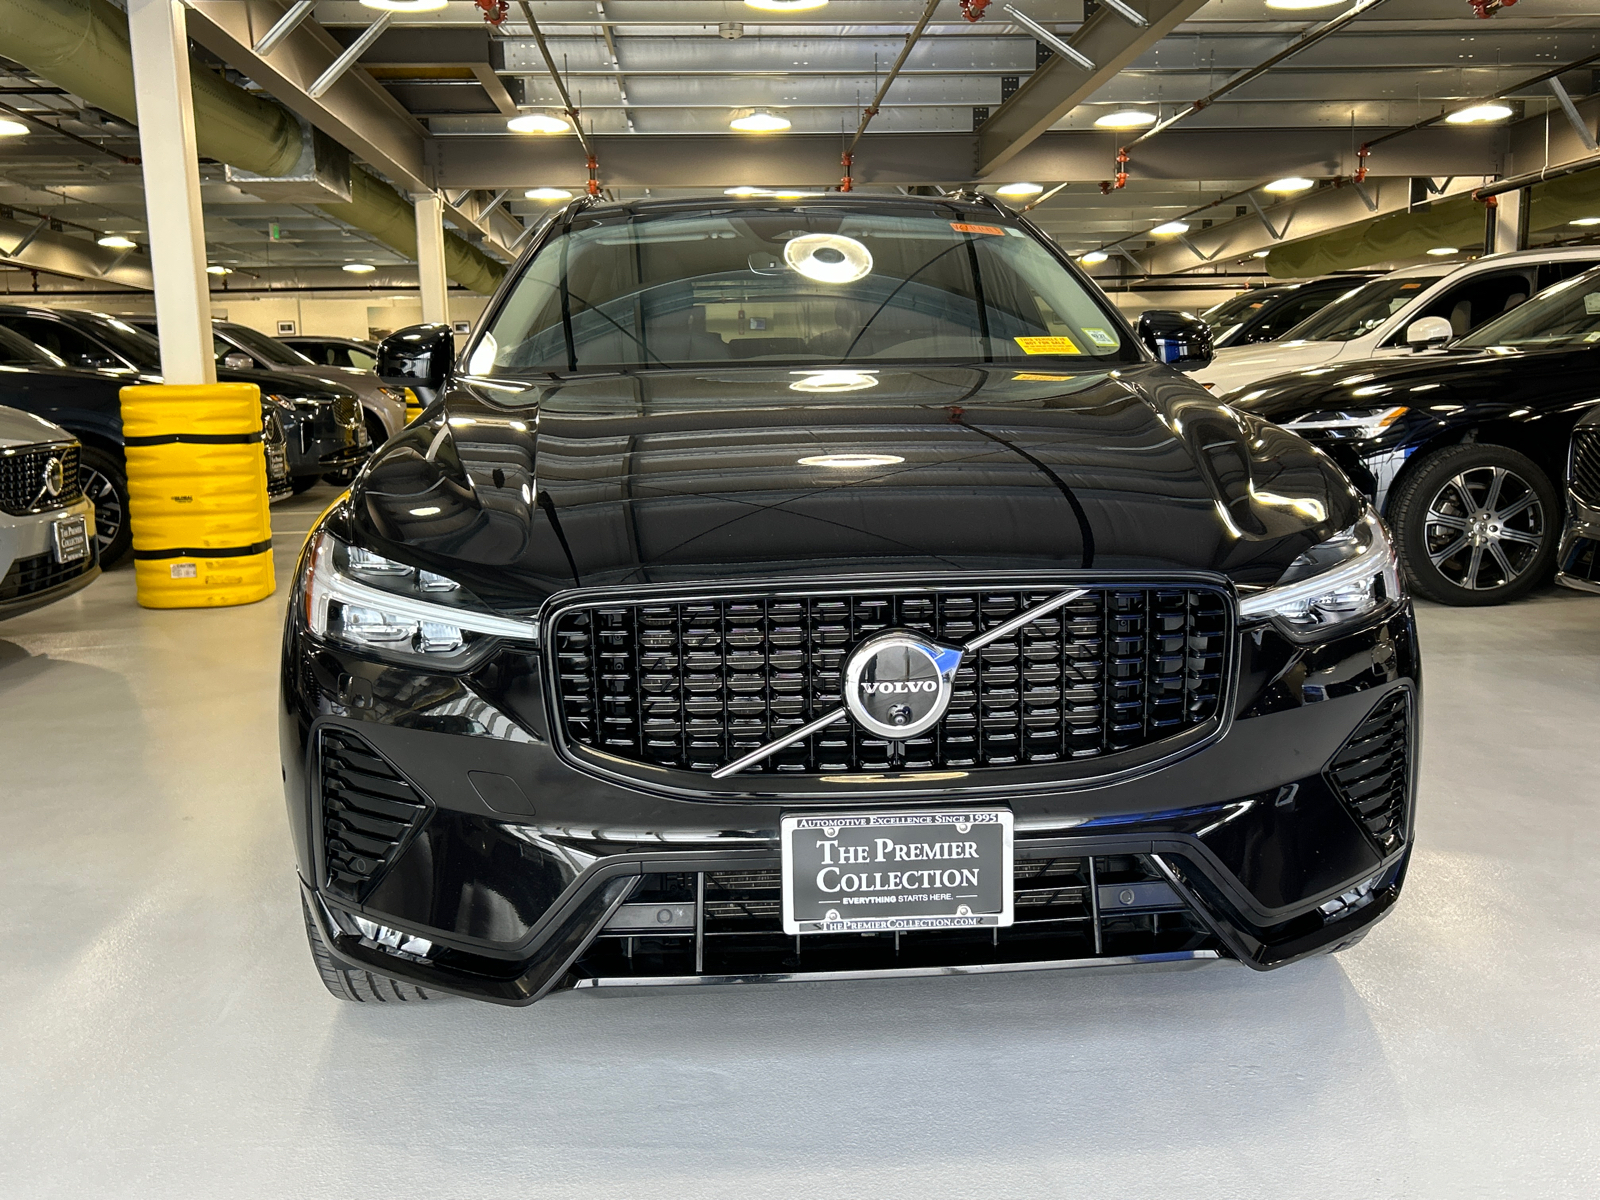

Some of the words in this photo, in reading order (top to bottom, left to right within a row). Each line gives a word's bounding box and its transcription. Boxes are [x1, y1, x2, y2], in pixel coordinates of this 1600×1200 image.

[861, 680, 938, 694] VOLVO
[799, 817, 867, 828] AUTOMOTIVE
[870, 815, 932, 825] EXCELLENCE
[935, 814, 966, 823] SINCE
[969, 813, 998, 823] 1995
[816, 839, 870, 865] THE
[874, 838, 980, 863] PREMIER
[816, 867, 980, 893] COLLECTION
[843, 896, 897, 905] EVERYTHING
[898, 894, 928, 903] STARTS
[930, 893, 954, 901] HERE.
